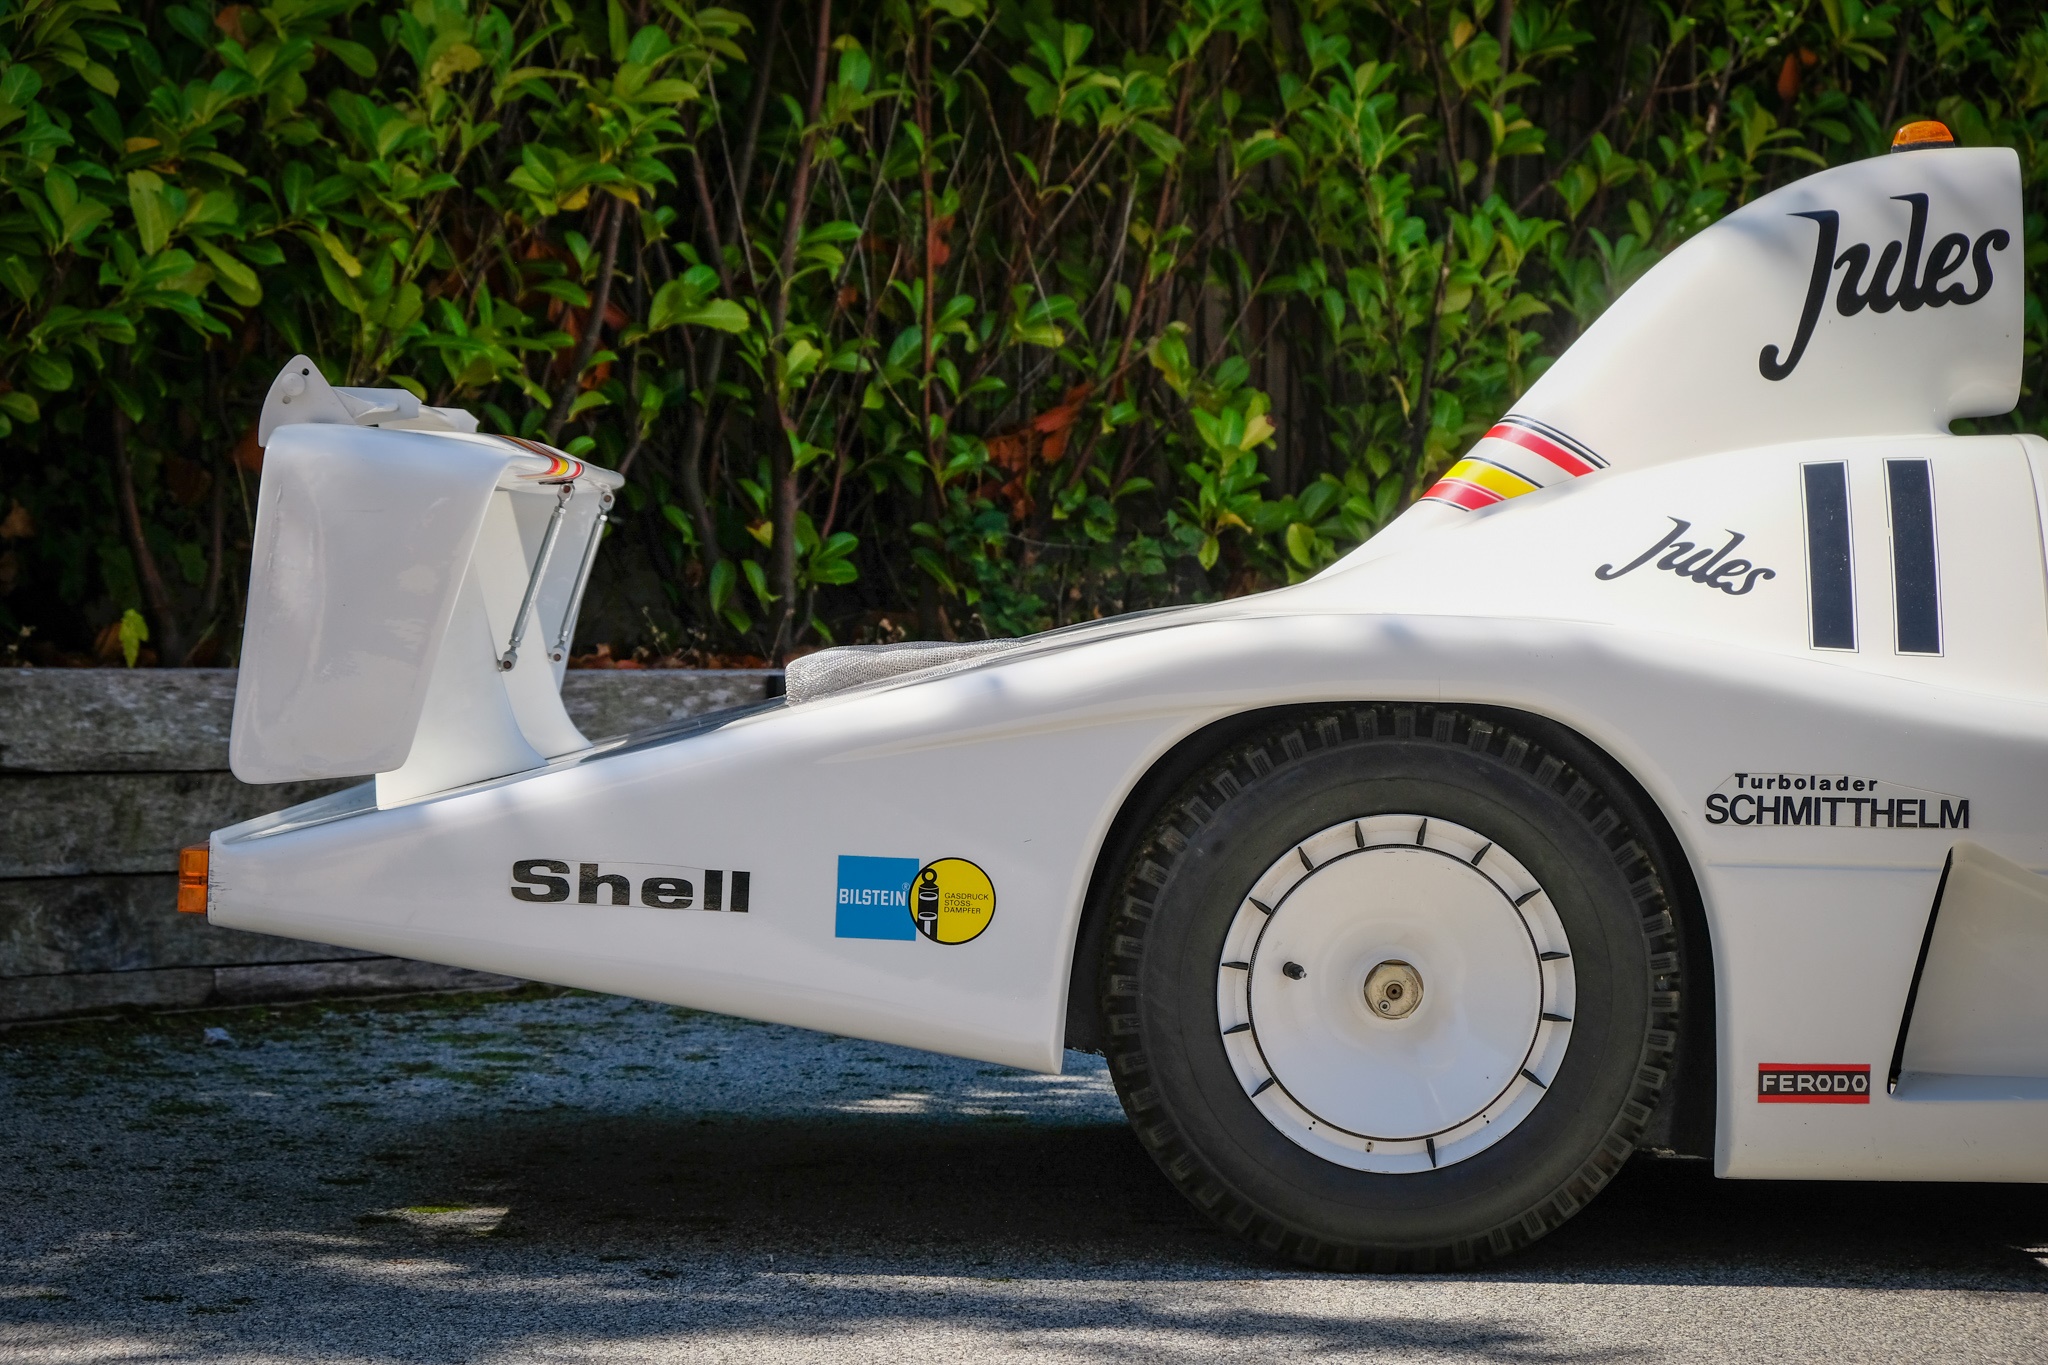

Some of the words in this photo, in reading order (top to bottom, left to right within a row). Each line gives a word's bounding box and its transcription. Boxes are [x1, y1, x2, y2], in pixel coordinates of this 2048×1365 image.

[1759, 192, 2010, 381] Jules
[1594, 516, 1776, 596] Jules
[1735, 773, 1877, 791] Turbolader
[1705, 793, 1970, 829] SCHMITTHELM
[511, 859, 750, 912] Shell
[944, 892, 989, 900] GASDRUCK
[944, 899, 973, 907] STOSS-
[1762, 1074, 1867, 1092] FERODO
